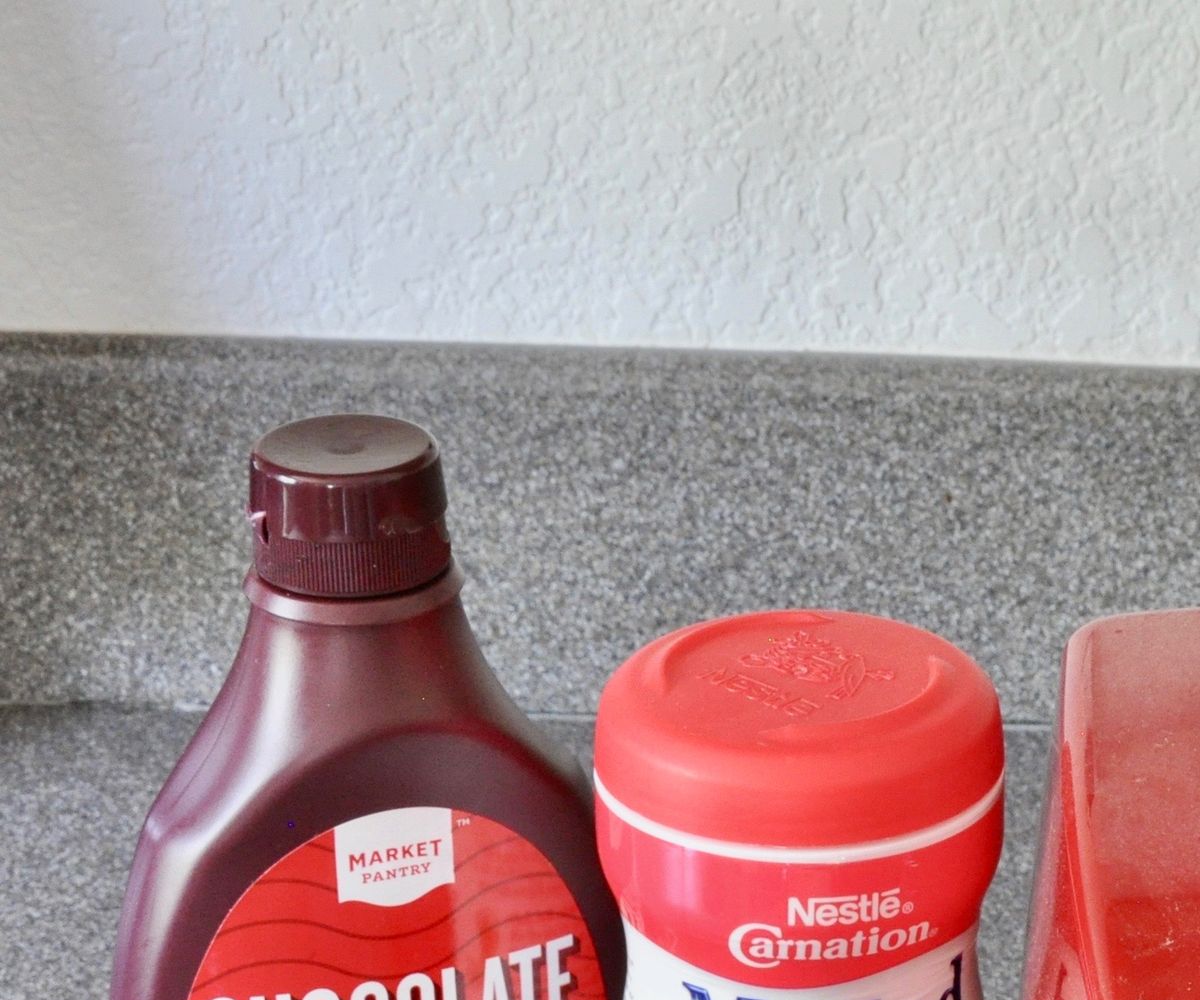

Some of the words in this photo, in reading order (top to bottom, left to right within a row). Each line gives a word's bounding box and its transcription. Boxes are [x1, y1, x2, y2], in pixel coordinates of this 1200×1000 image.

[348, 838, 442, 872] MARKET
[362, 862, 431, 884] PANTRY
[728, 920, 931, 969] Carnation
